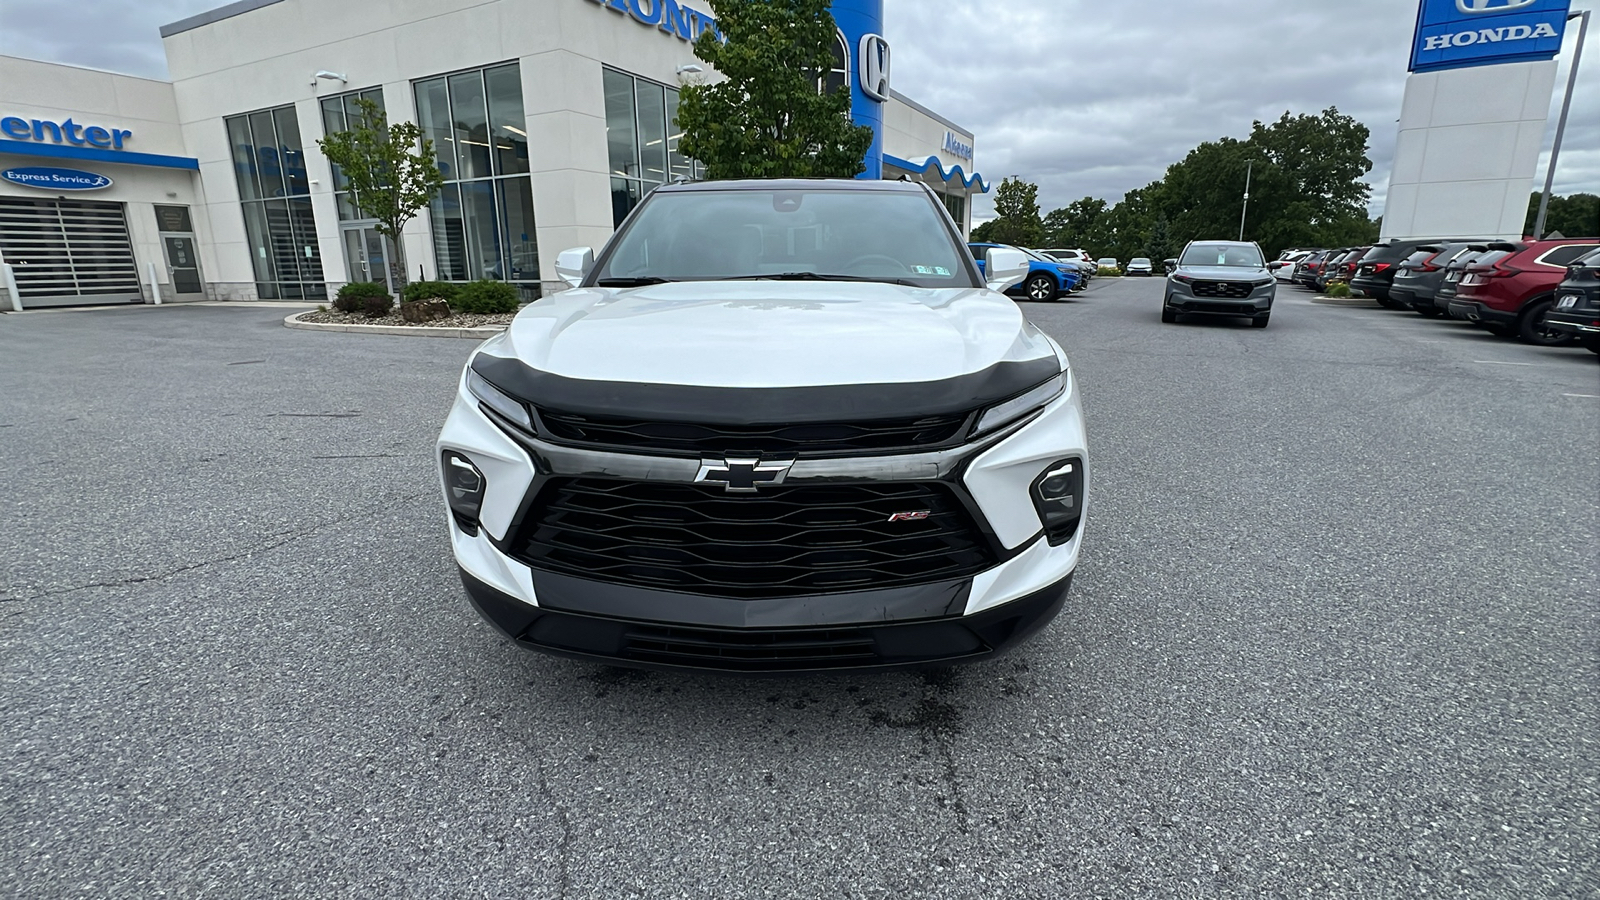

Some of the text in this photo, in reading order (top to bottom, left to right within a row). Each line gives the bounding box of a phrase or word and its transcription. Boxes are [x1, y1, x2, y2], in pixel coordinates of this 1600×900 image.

[1423, 23, 1557, 51] HONDA
[1, 116, 132, 149] enter
[7, 171, 91, 184] Express Service
[887, 510, 931, 522] RS
